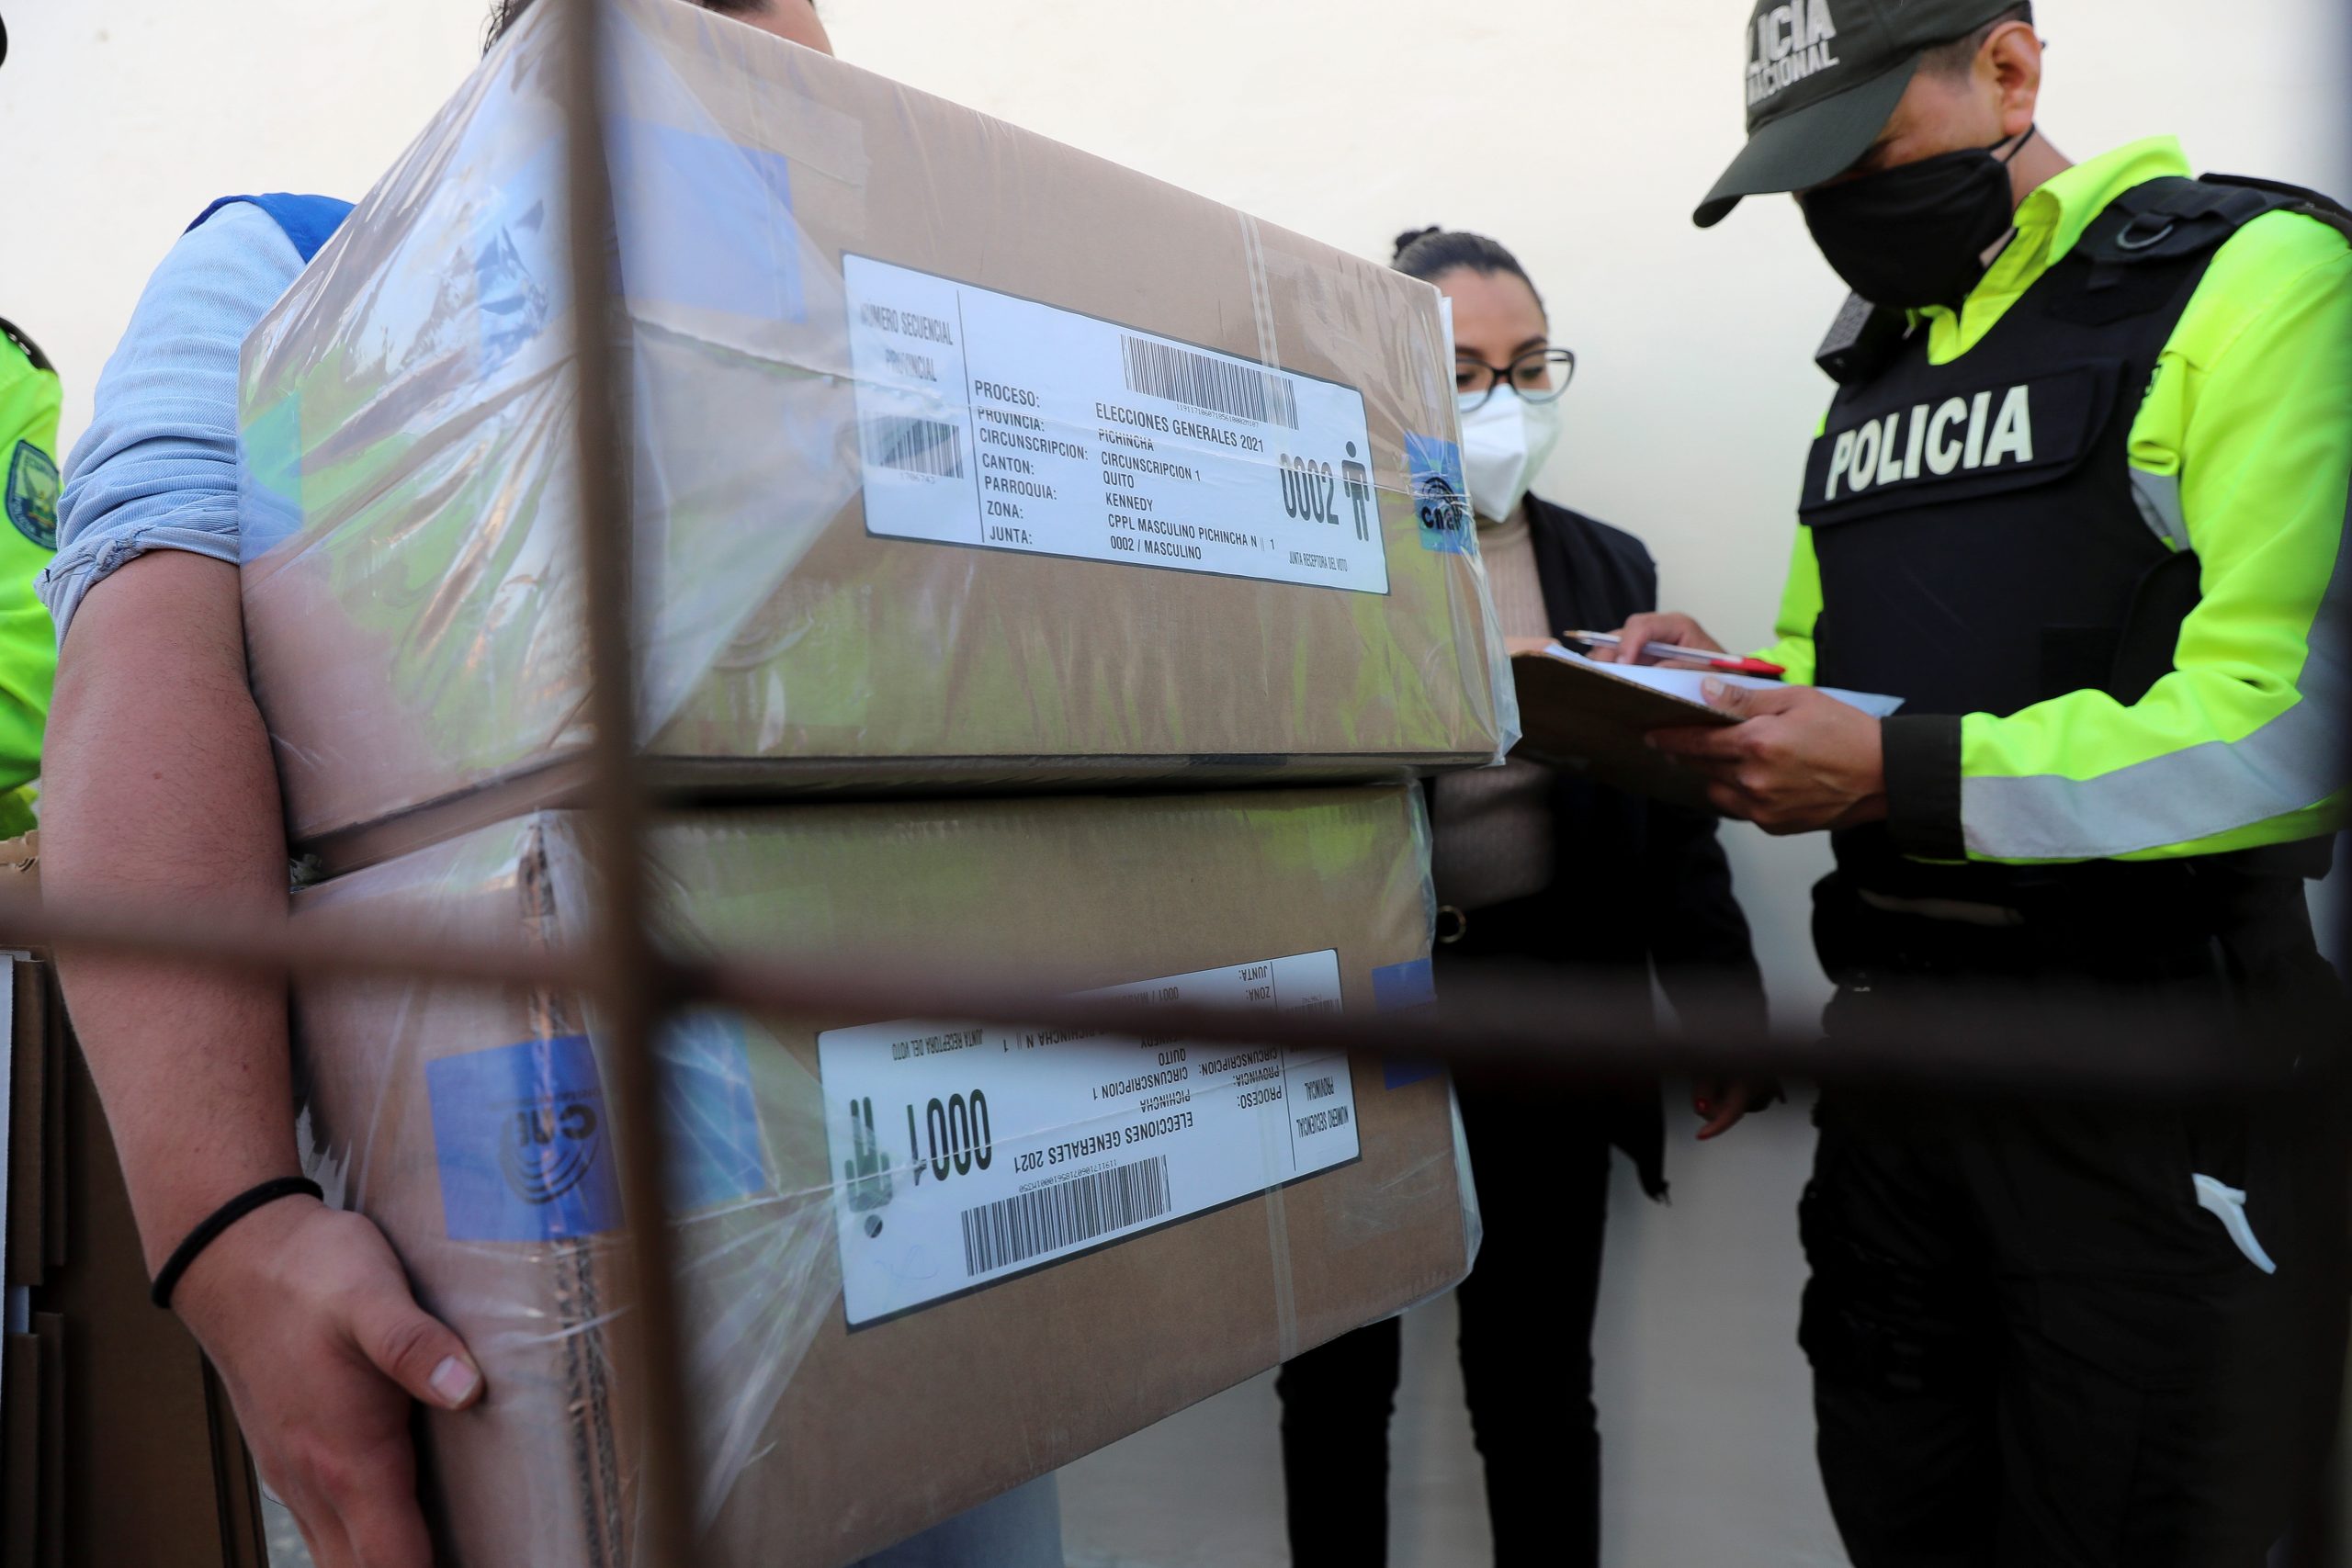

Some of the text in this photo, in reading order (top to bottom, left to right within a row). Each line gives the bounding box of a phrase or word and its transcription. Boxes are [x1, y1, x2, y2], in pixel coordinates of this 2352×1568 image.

[901, 310, 953, 345] SECUENCIAL
[885, 348, 937, 382] PROVINCIAL
[975, 379, 1040, 408] PROCESO:
[978, 406, 1045, 432] PROVINCIA:
[1096, 402, 1264, 453] ELECCIONES GENERALES 2021
[979, 427, 1088, 460] CIRCUNSCRIPCION:
[1099, 428, 1154, 451] PICHINCHA
[1825, 385, 2033, 501] POLICIA
[982, 453, 1035, 475] CANTON:
[1102, 451, 1201, 481] CIRCUNSCRIPCION 1
[985, 476, 1057, 500] PARROQUIA:
[1102, 471, 1135, 489] QUITO
[1280, 453, 1340, 525] 0002
[987, 501, 1023, 519] ZONA:
[1105, 491, 1153, 512] KENNEDY
[989, 525, 1033, 544] JUNTA:
[1108, 513, 1136, 531] CPPL
[1138, 518, 1195, 539] MASCULINO
[1198, 527, 1248, 546] PICHINCHA
[1110, 536, 1135, 551] 0002
[1145, 540, 1202, 560] MASCULINO
[1289, 551, 1304, 566] JUNTA
[1303, 553, 1329, 570] RECEPTORA
[1329, 557, 1337, 570] DEL
[1238, 965, 1268, 982] JUNTA:
[1159, 987, 1179, 1002] 0001
[1246, 986, 1271, 1001] ZONA:
[892, 1029, 983, 1061] JUNTA RECEPTORA DEL VOTO
[1158, 1048, 1186, 1066] QUITO
[1198, 1046, 1277, 1076] CIRCUNSCRIPCION:
[1092, 1066, 1188, 1100] CIRCUNSCRIPCION 1
[1232, 1066, 1280, 1087] PROVINCIA:
[1305, 1076, 1334, 1101] PROVINCIAL
[1140, 1089, 1191, 1113] PICHINCHA
[1237, 1085, 1283, 1110] PROCESO:
[1296, 1111, 1328, 1138] SECUENCIAL
[907, 1089, 992, 1186] 0001
[1014, 1111, 1193, 1174] ELECCIONES GENERALES 2021
